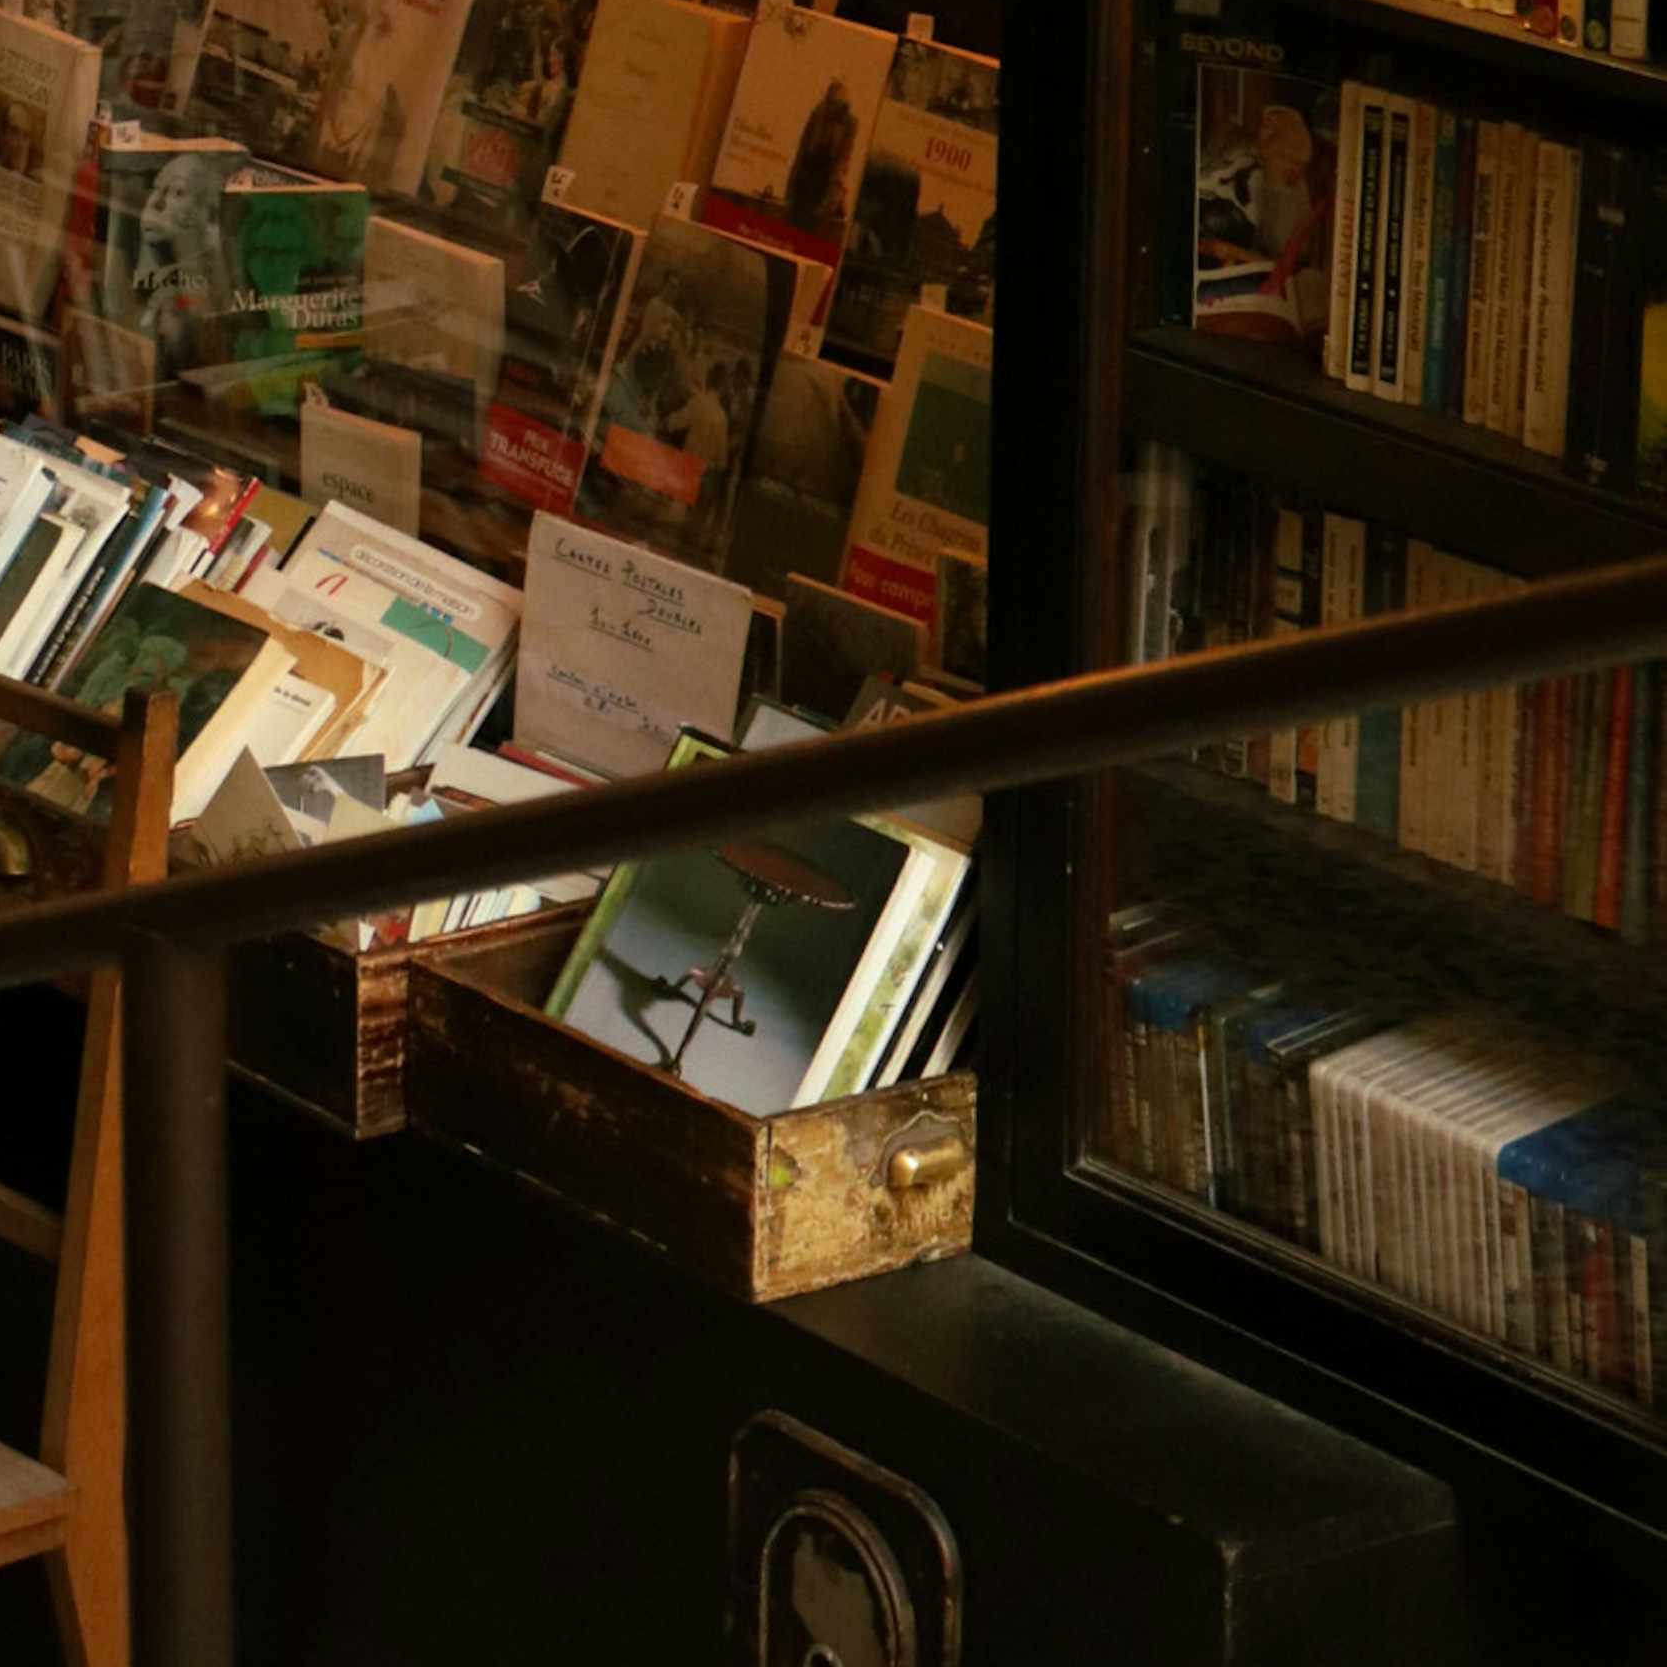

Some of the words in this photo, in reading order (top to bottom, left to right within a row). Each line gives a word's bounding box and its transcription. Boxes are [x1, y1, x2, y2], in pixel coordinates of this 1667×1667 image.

[1180, 32, 1285, 62] BEYOND
[923, 136, 973, 172] 1900
[232, 287, 360, 313] Marguerite
[293, 308, 360, 329] Duras
[322, 471, 375, 504] espace
